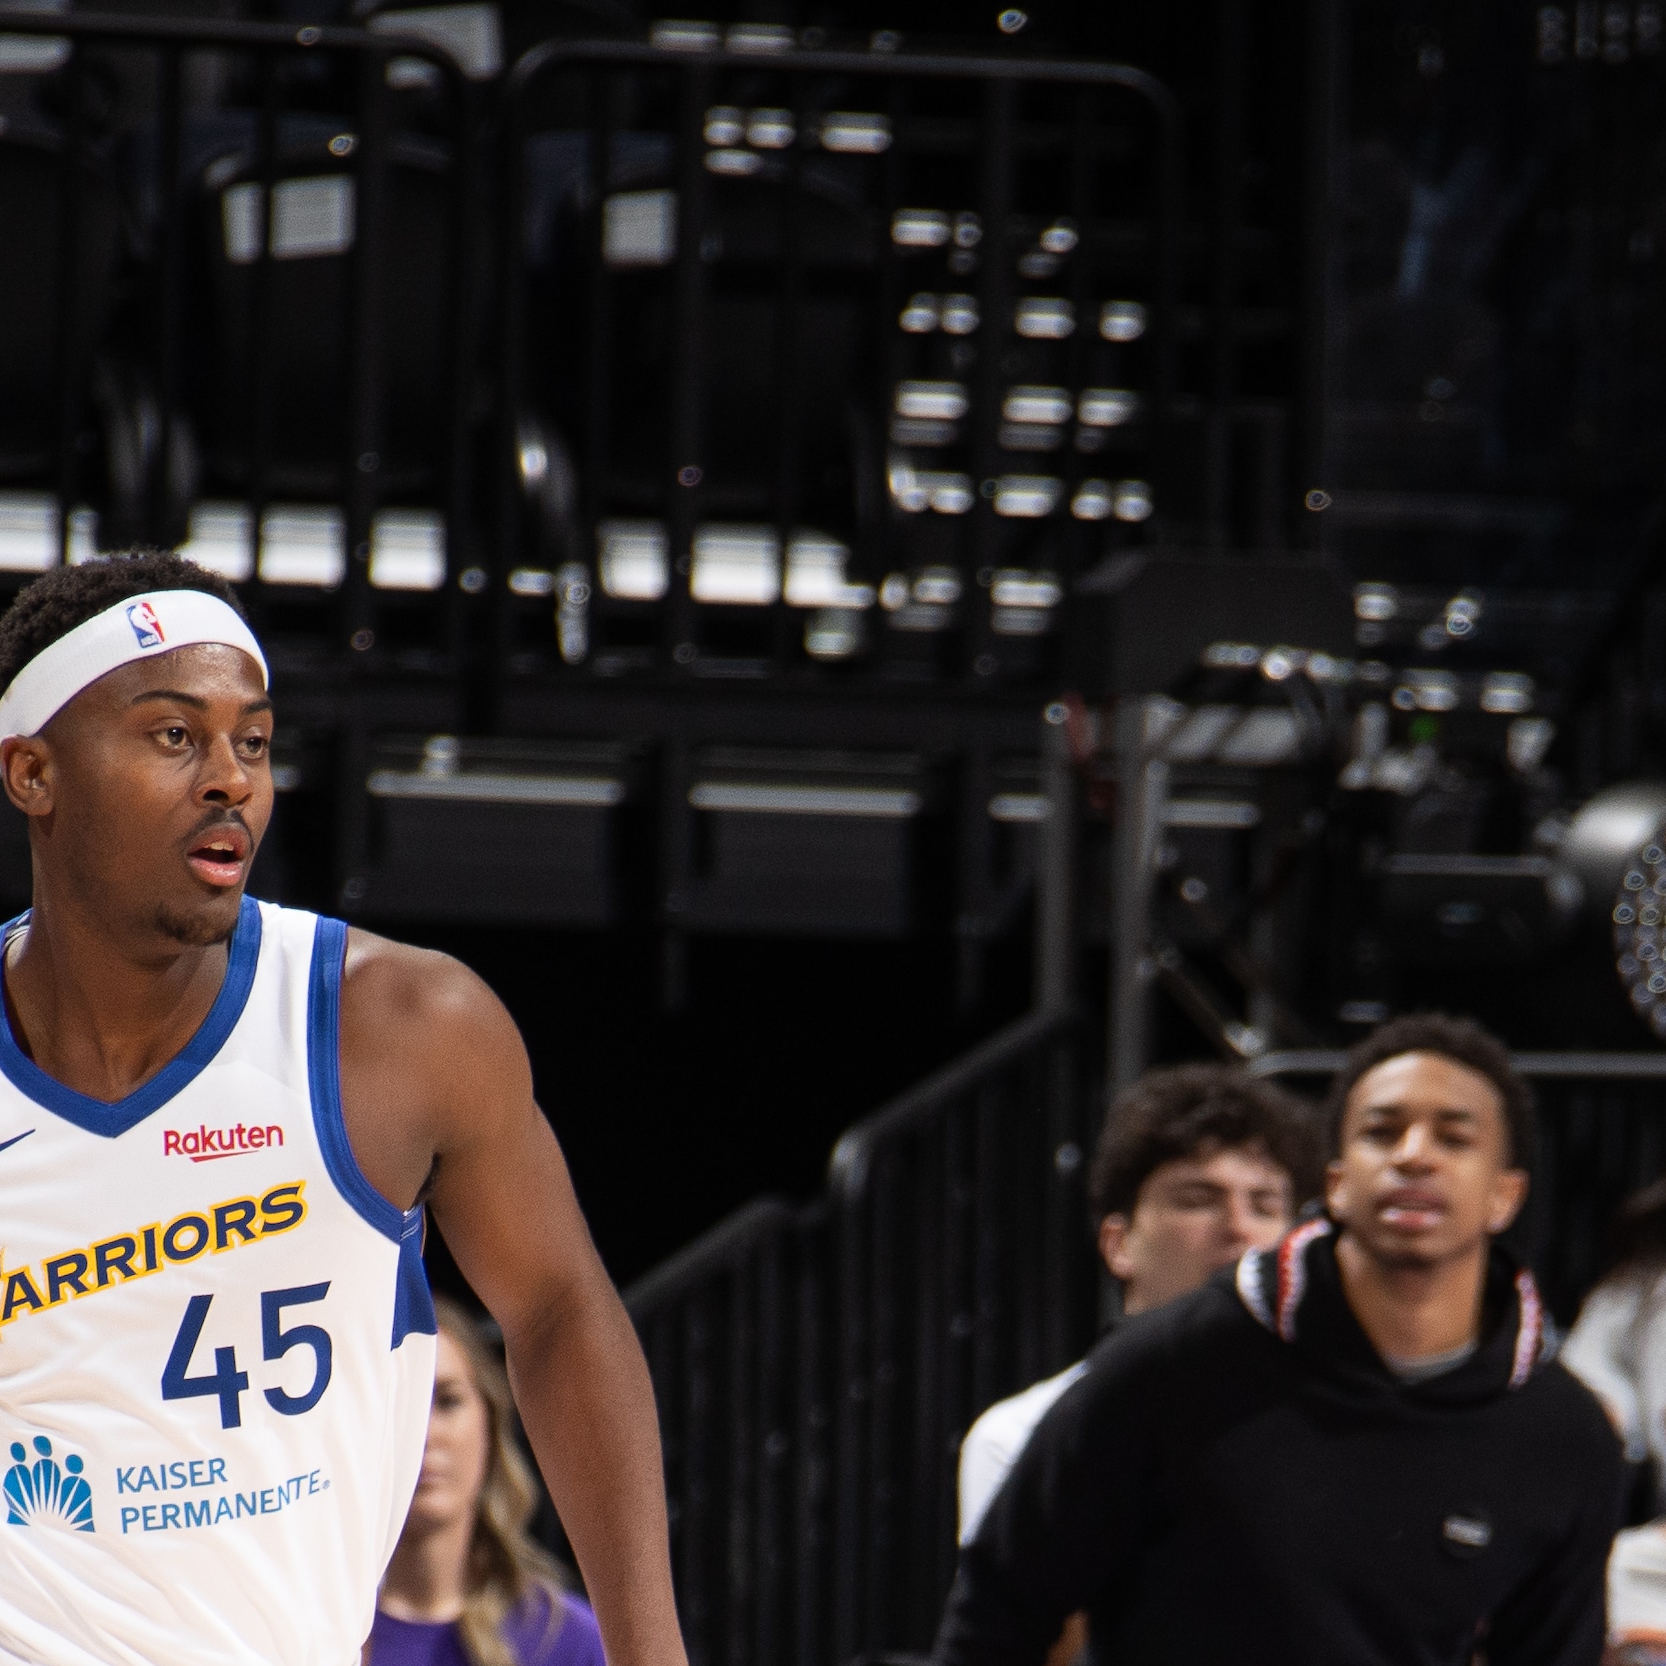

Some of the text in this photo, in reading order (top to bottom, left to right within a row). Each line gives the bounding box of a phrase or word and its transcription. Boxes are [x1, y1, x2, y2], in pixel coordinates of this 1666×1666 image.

[163, 1122, 284, 1157] Rakuten
[161, 1280, 332, 1430] 45
[116, 1457, 228, 1495] KAISER
